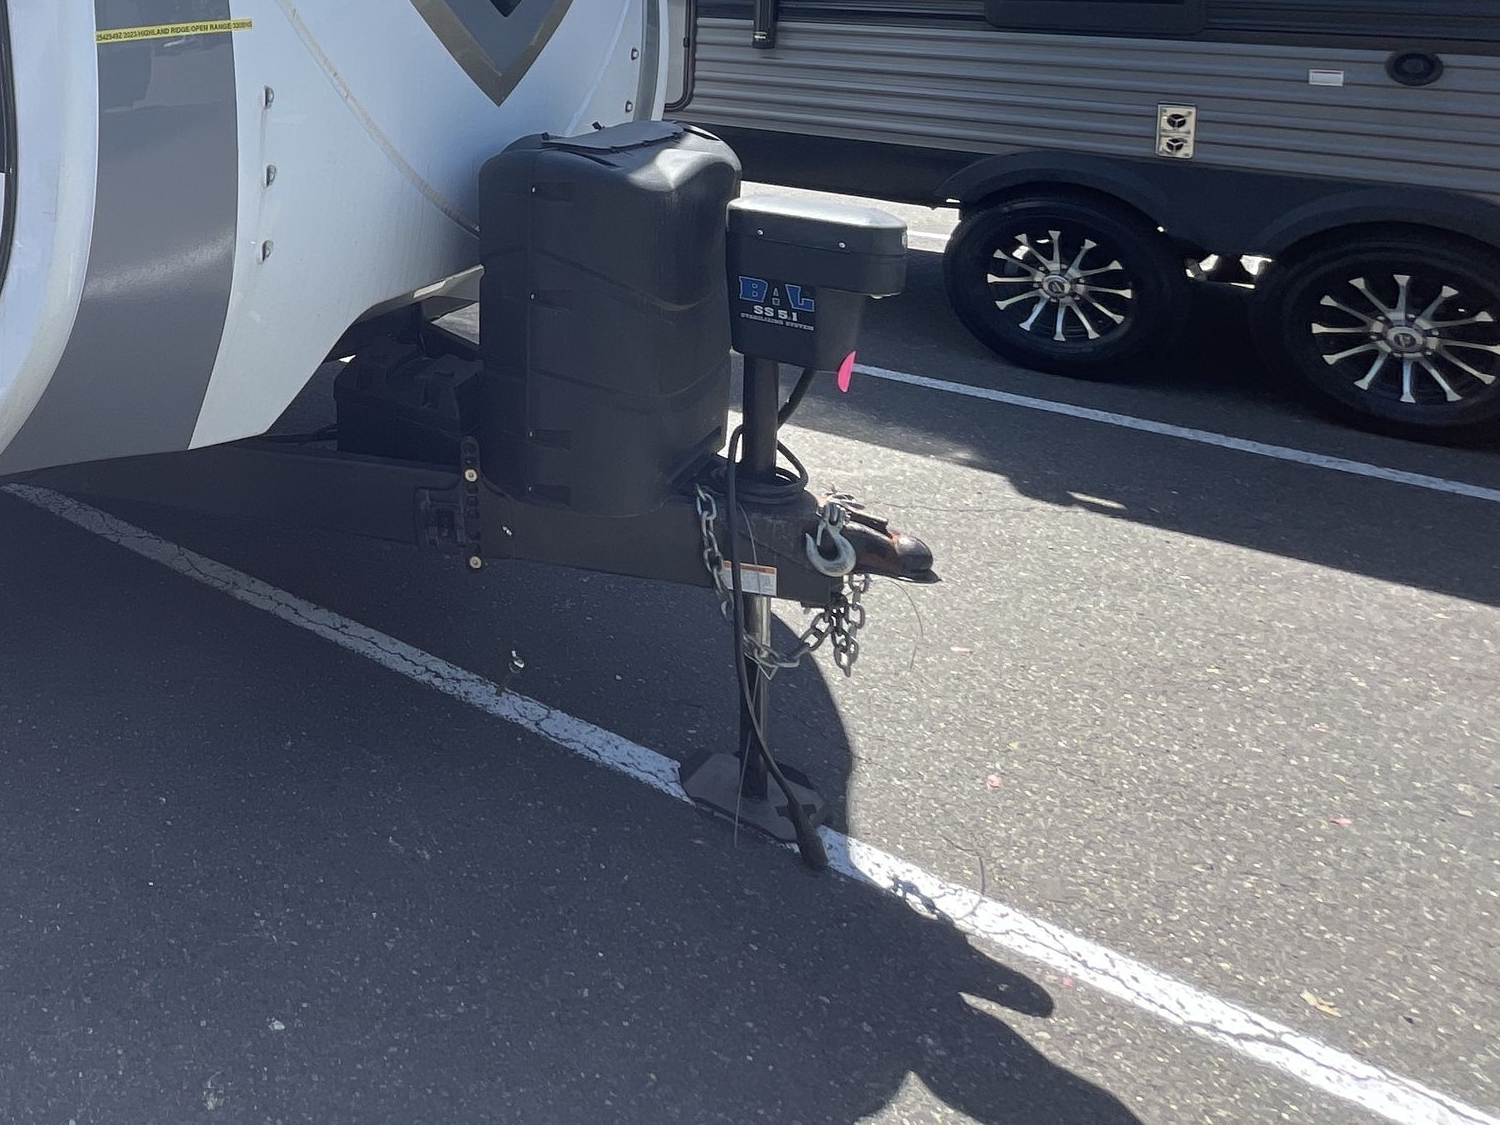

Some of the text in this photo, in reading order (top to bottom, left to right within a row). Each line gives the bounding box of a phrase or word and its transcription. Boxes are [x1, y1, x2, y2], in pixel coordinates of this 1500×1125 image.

[123, 31, 137, 39] 2023
[137, 28, 169, 38] HIGHLAND
[171, 25, 190, 34] RIDGE
[191, 24, 208, 33] OPEN
[210, 22, 232, 31] RANGE
[754, 305, 798, 321] SS 5.1
